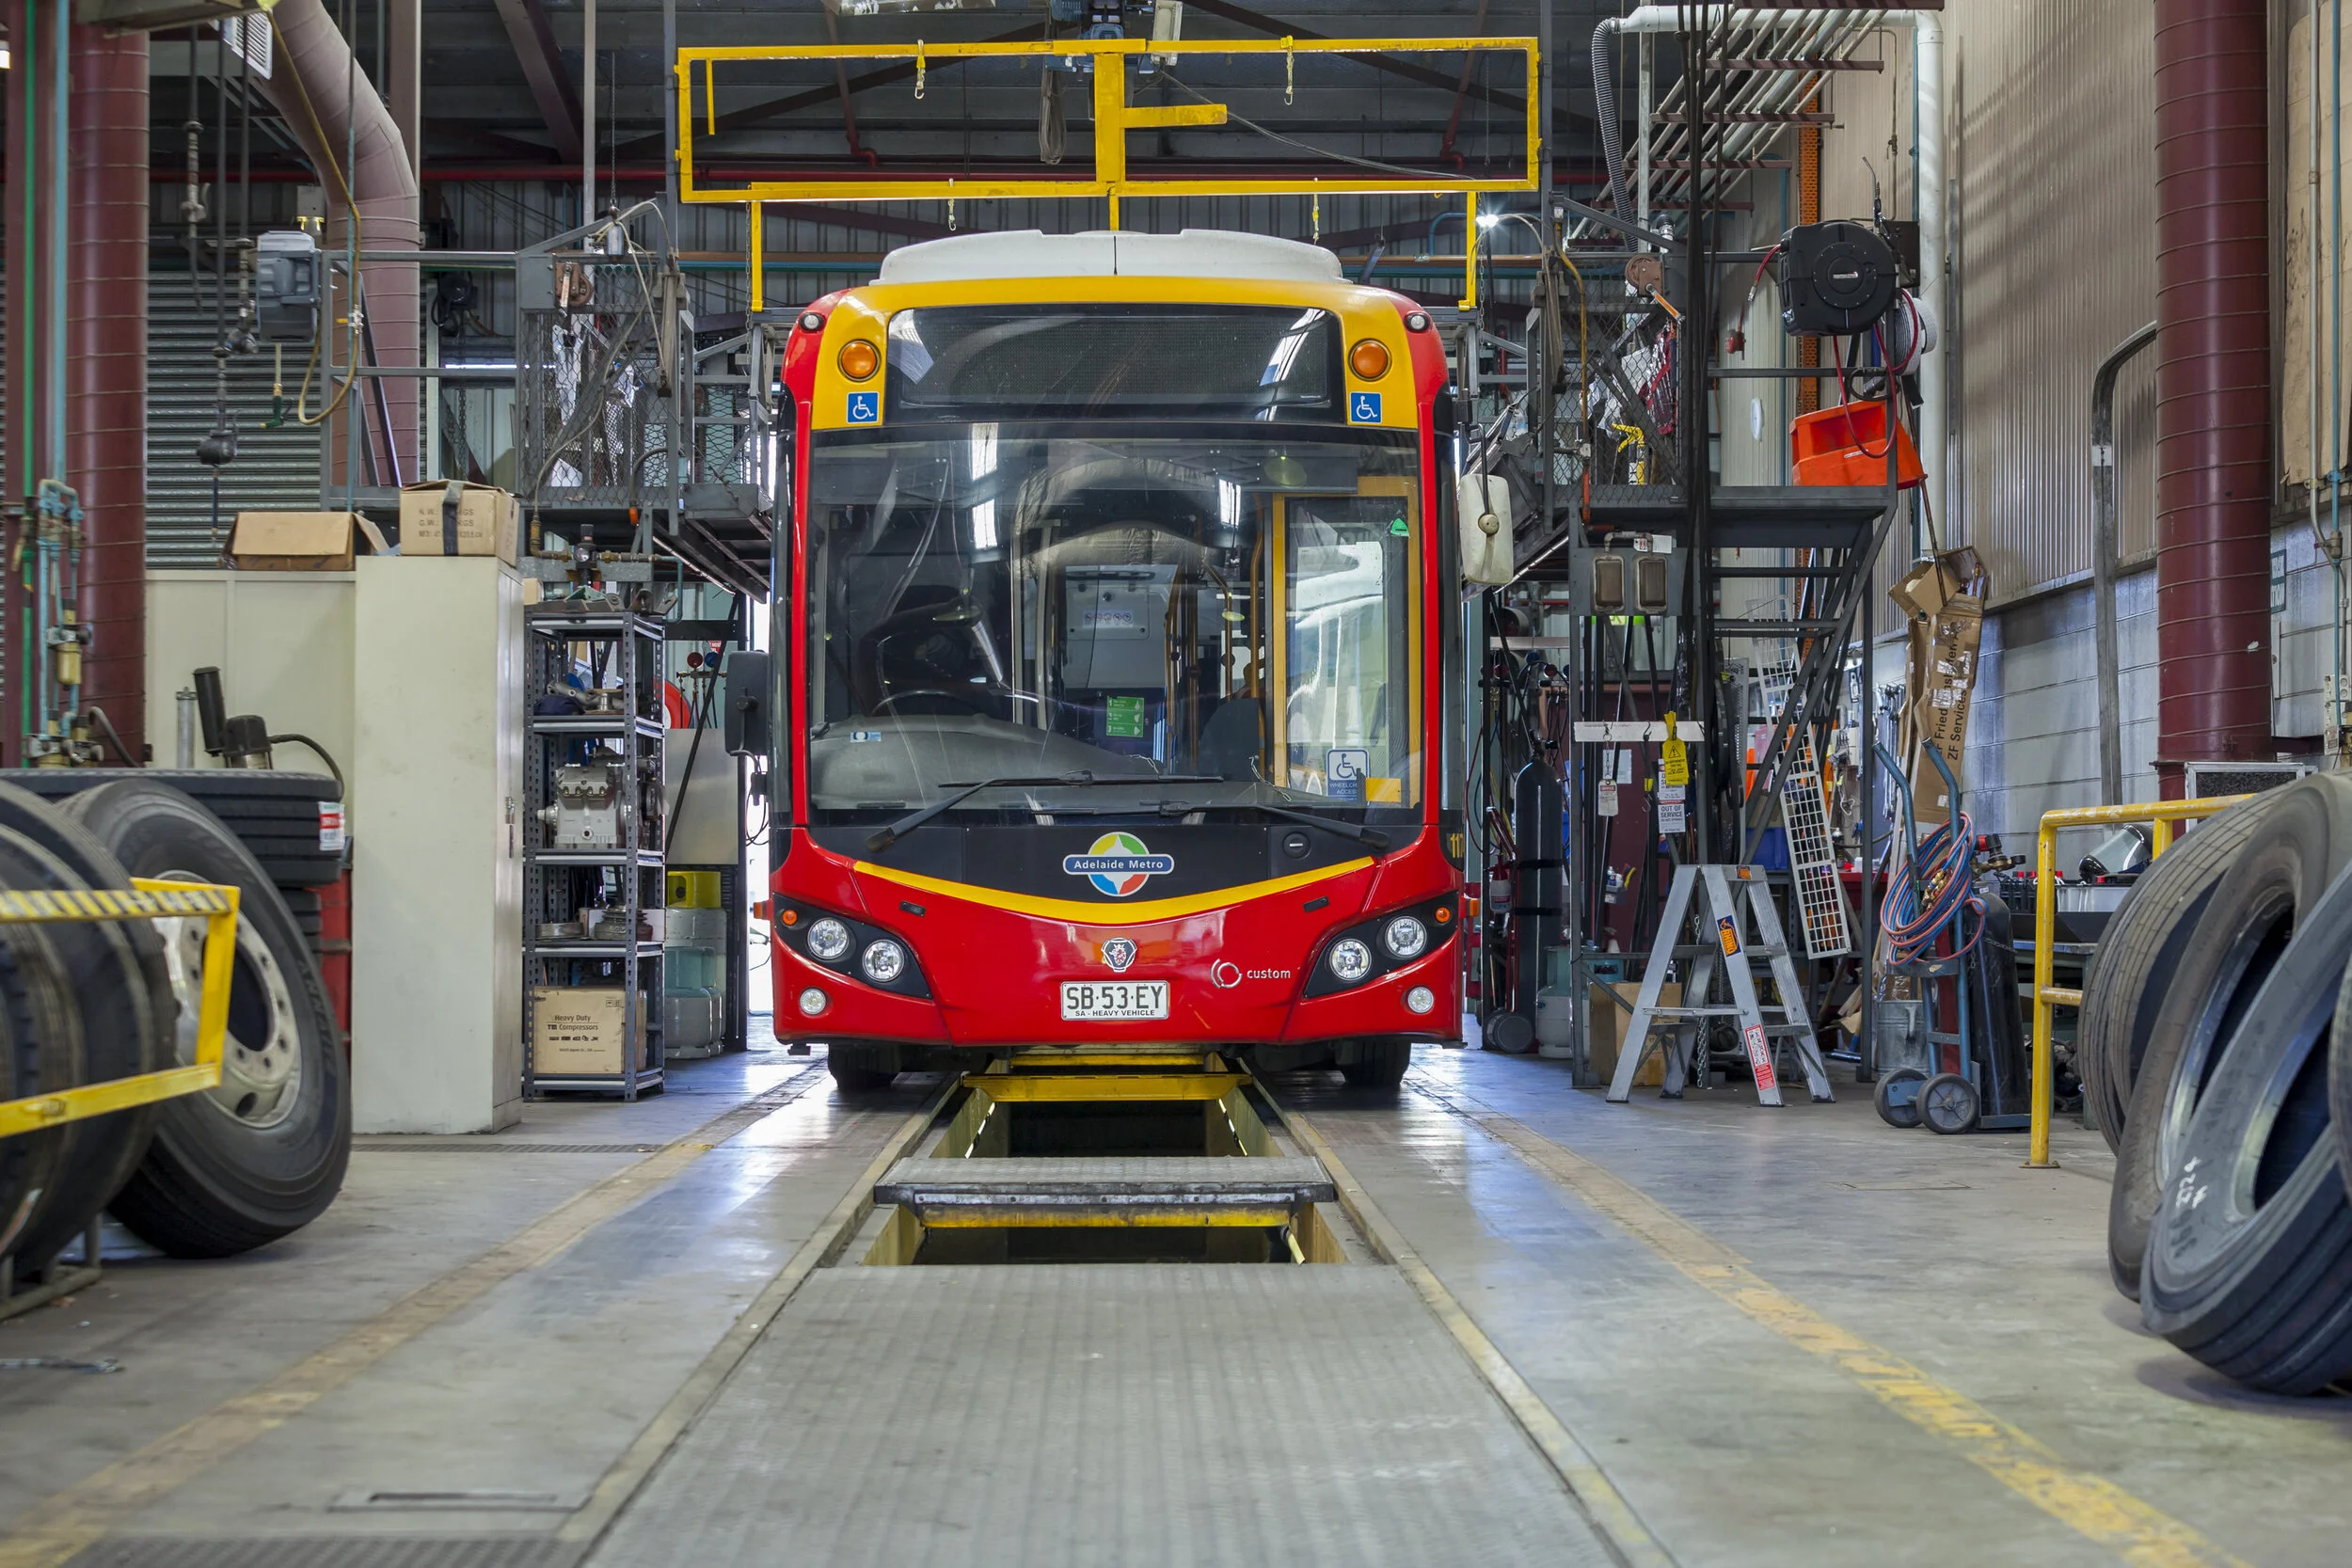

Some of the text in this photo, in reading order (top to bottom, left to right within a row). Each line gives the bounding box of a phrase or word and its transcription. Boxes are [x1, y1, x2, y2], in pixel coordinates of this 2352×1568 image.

[1947, 689, 1967, 761] ZF Services
[1073, 860, 1164, 869] Adelaide Metro
[1247, 968, 1291, 979] custom
